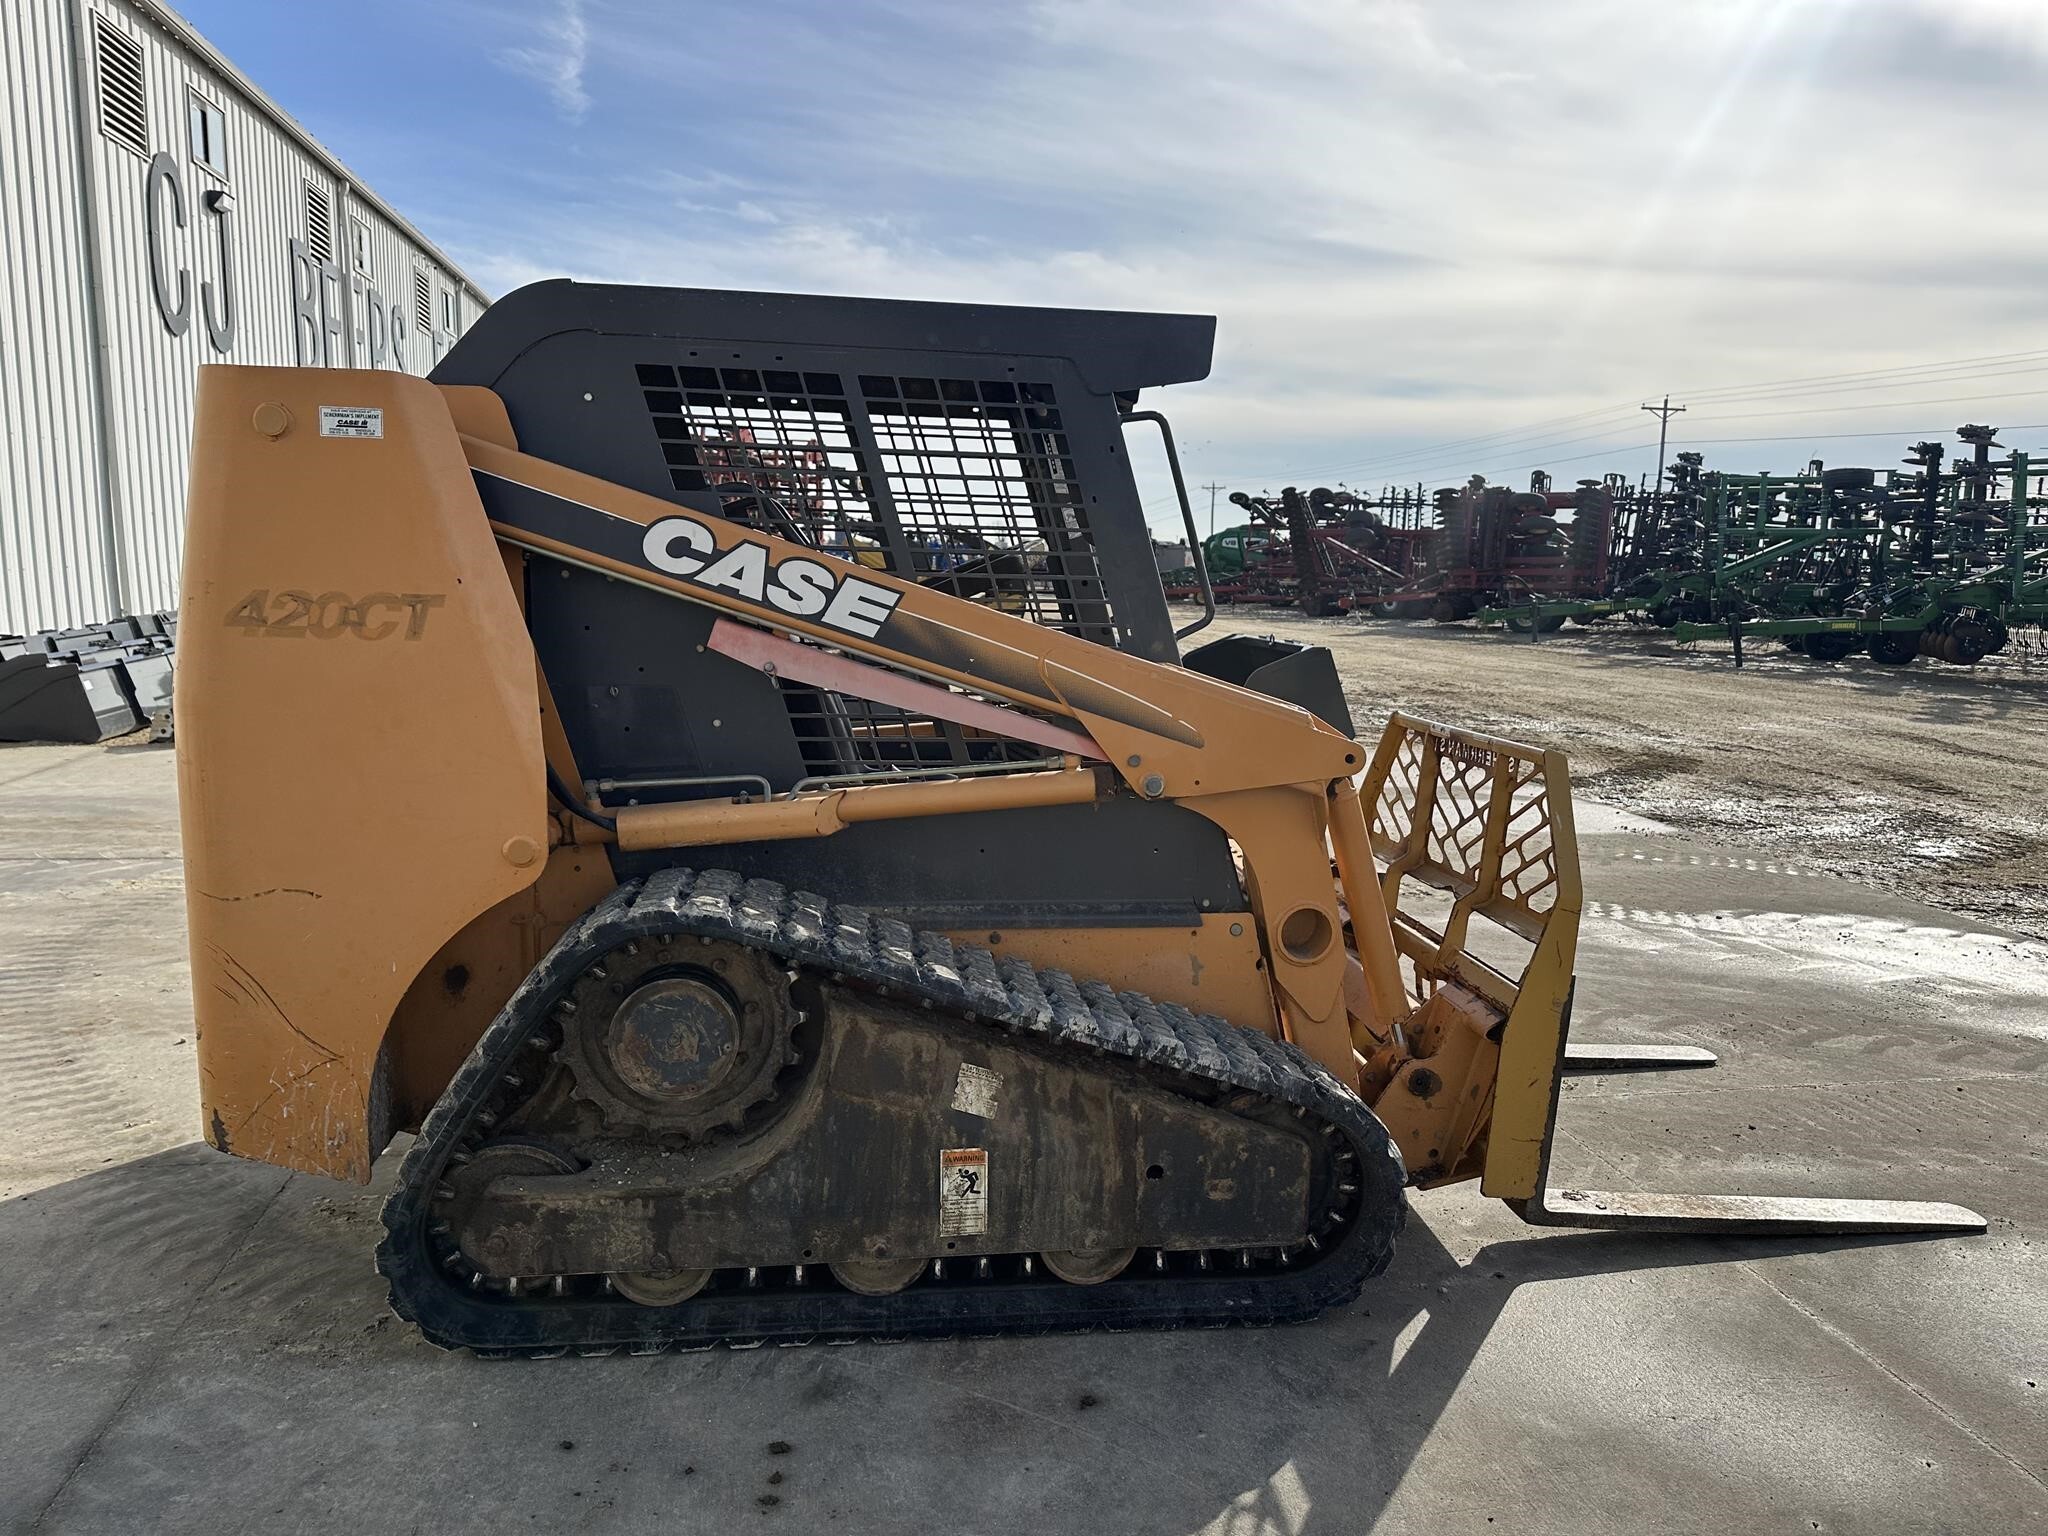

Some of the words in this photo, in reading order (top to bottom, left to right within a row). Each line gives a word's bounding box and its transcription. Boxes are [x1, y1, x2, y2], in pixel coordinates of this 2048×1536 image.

[642, 517, 901, 639] CASE
[223, 588, 448, 641] 420CT
[952, 1154, 984, 1162] WARNING
